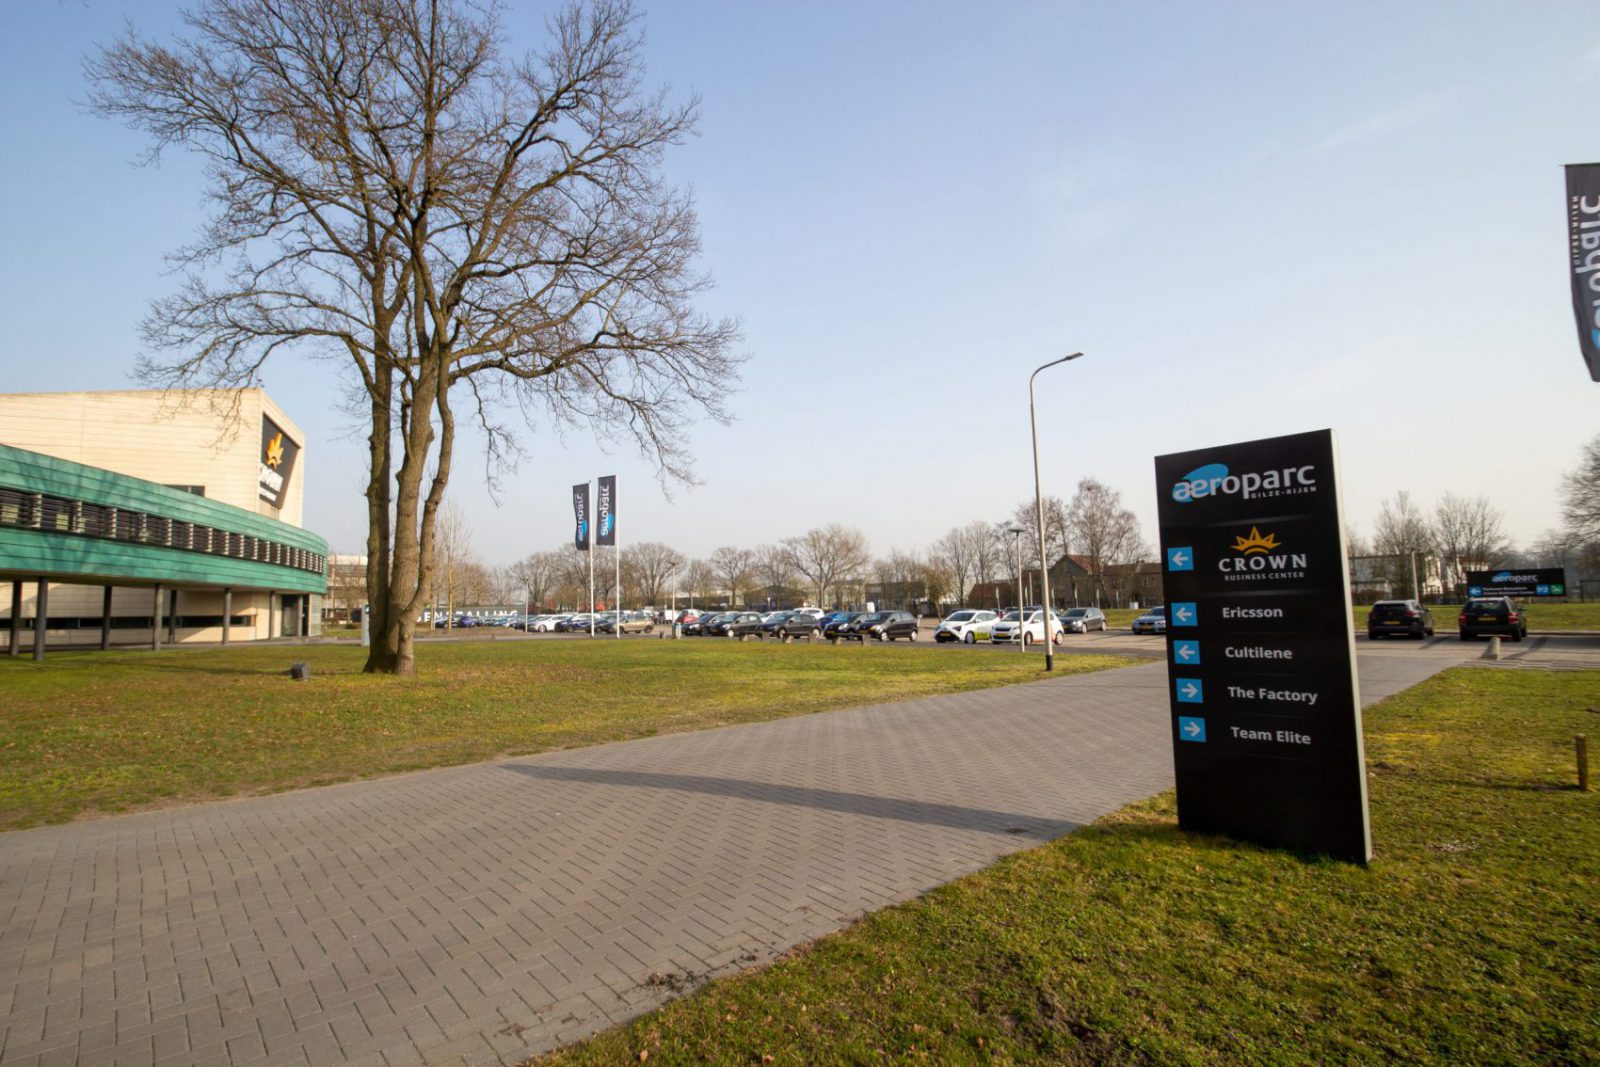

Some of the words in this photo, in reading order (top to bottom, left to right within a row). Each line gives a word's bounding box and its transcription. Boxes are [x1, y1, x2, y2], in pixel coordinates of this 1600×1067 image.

[1172, 465, 1316, 499] aeroparc
[1251, 486, 1317, 498] GILZE-RIJEN
[1218, 554, 1307, 572] CROWN
[1224, 573, 1266, 581] BUSINESS
[1268, 571, 1304, 580] CENTER
[1222, 607, 1283, 618] Ericsson
[1225, 646, 1292, 659] Cultilene
[1228, 686, 1255, 699] The
[1259, 688, 1318, 705] Factory
[1231, 726, 1272, 741] Team
[1276, 730, 1311, 744] Elite
